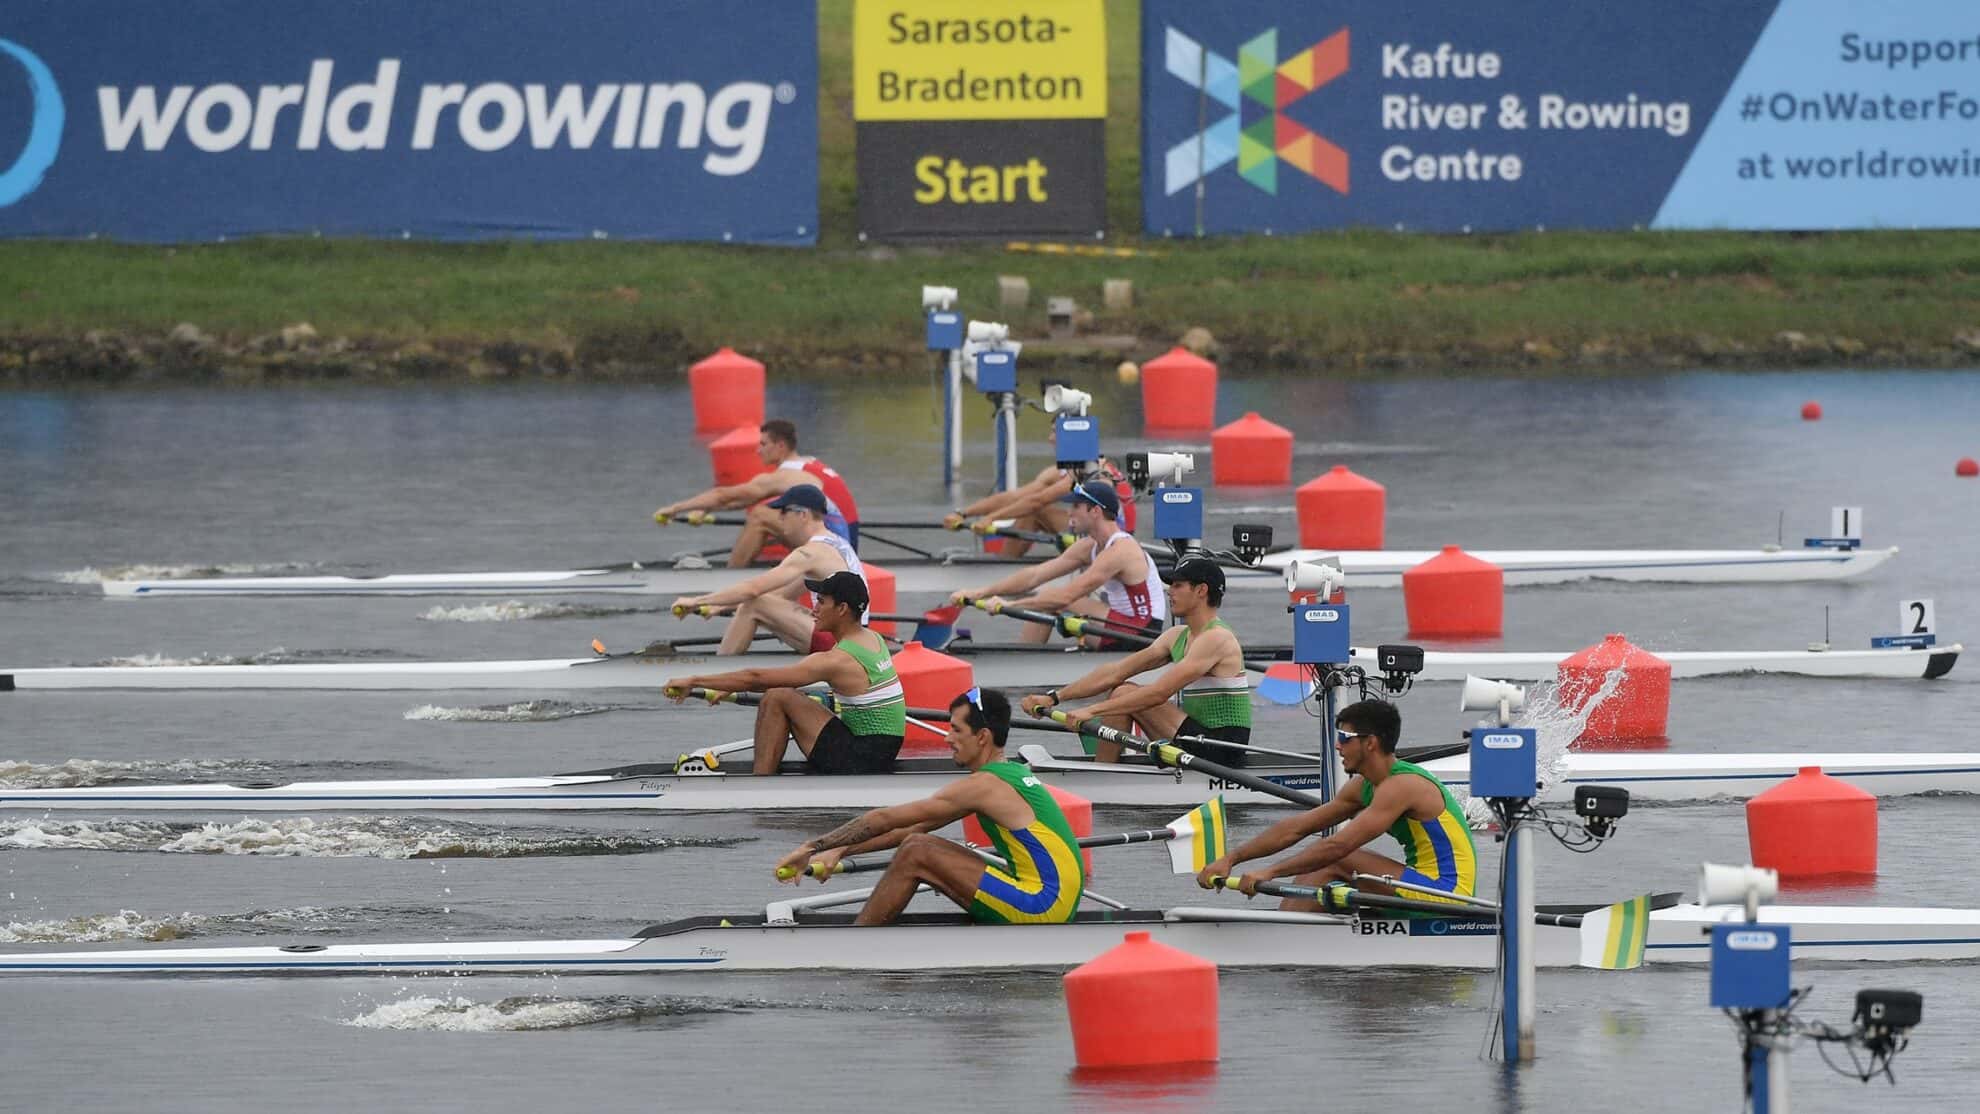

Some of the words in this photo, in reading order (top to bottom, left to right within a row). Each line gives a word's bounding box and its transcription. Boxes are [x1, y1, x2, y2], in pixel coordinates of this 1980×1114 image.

[888, 12, 1071, 44] Sarasota-
[1382, 43, 1500, 79] Kafue
[878, 68, 1082, 102] Bradenton
[98, 59, 401, 153] world
[412, 82, 773, 176] rowing
[1382, 95, 1487, 130] River
[1497, 95, 1527, 130] &
[1539, 93, 1690, 137] Rowing
[1380, 145, 1522, 181] Centre
[1737, 151, 1774, 180] at
[914, 156, 1047, 204] Start
[1133, 594, 1149, 620] US
[1910, 601, 1928, 634] 2
[1361, 921, 1407, 935] BRA
[1449, 922, 1475, 930] world
